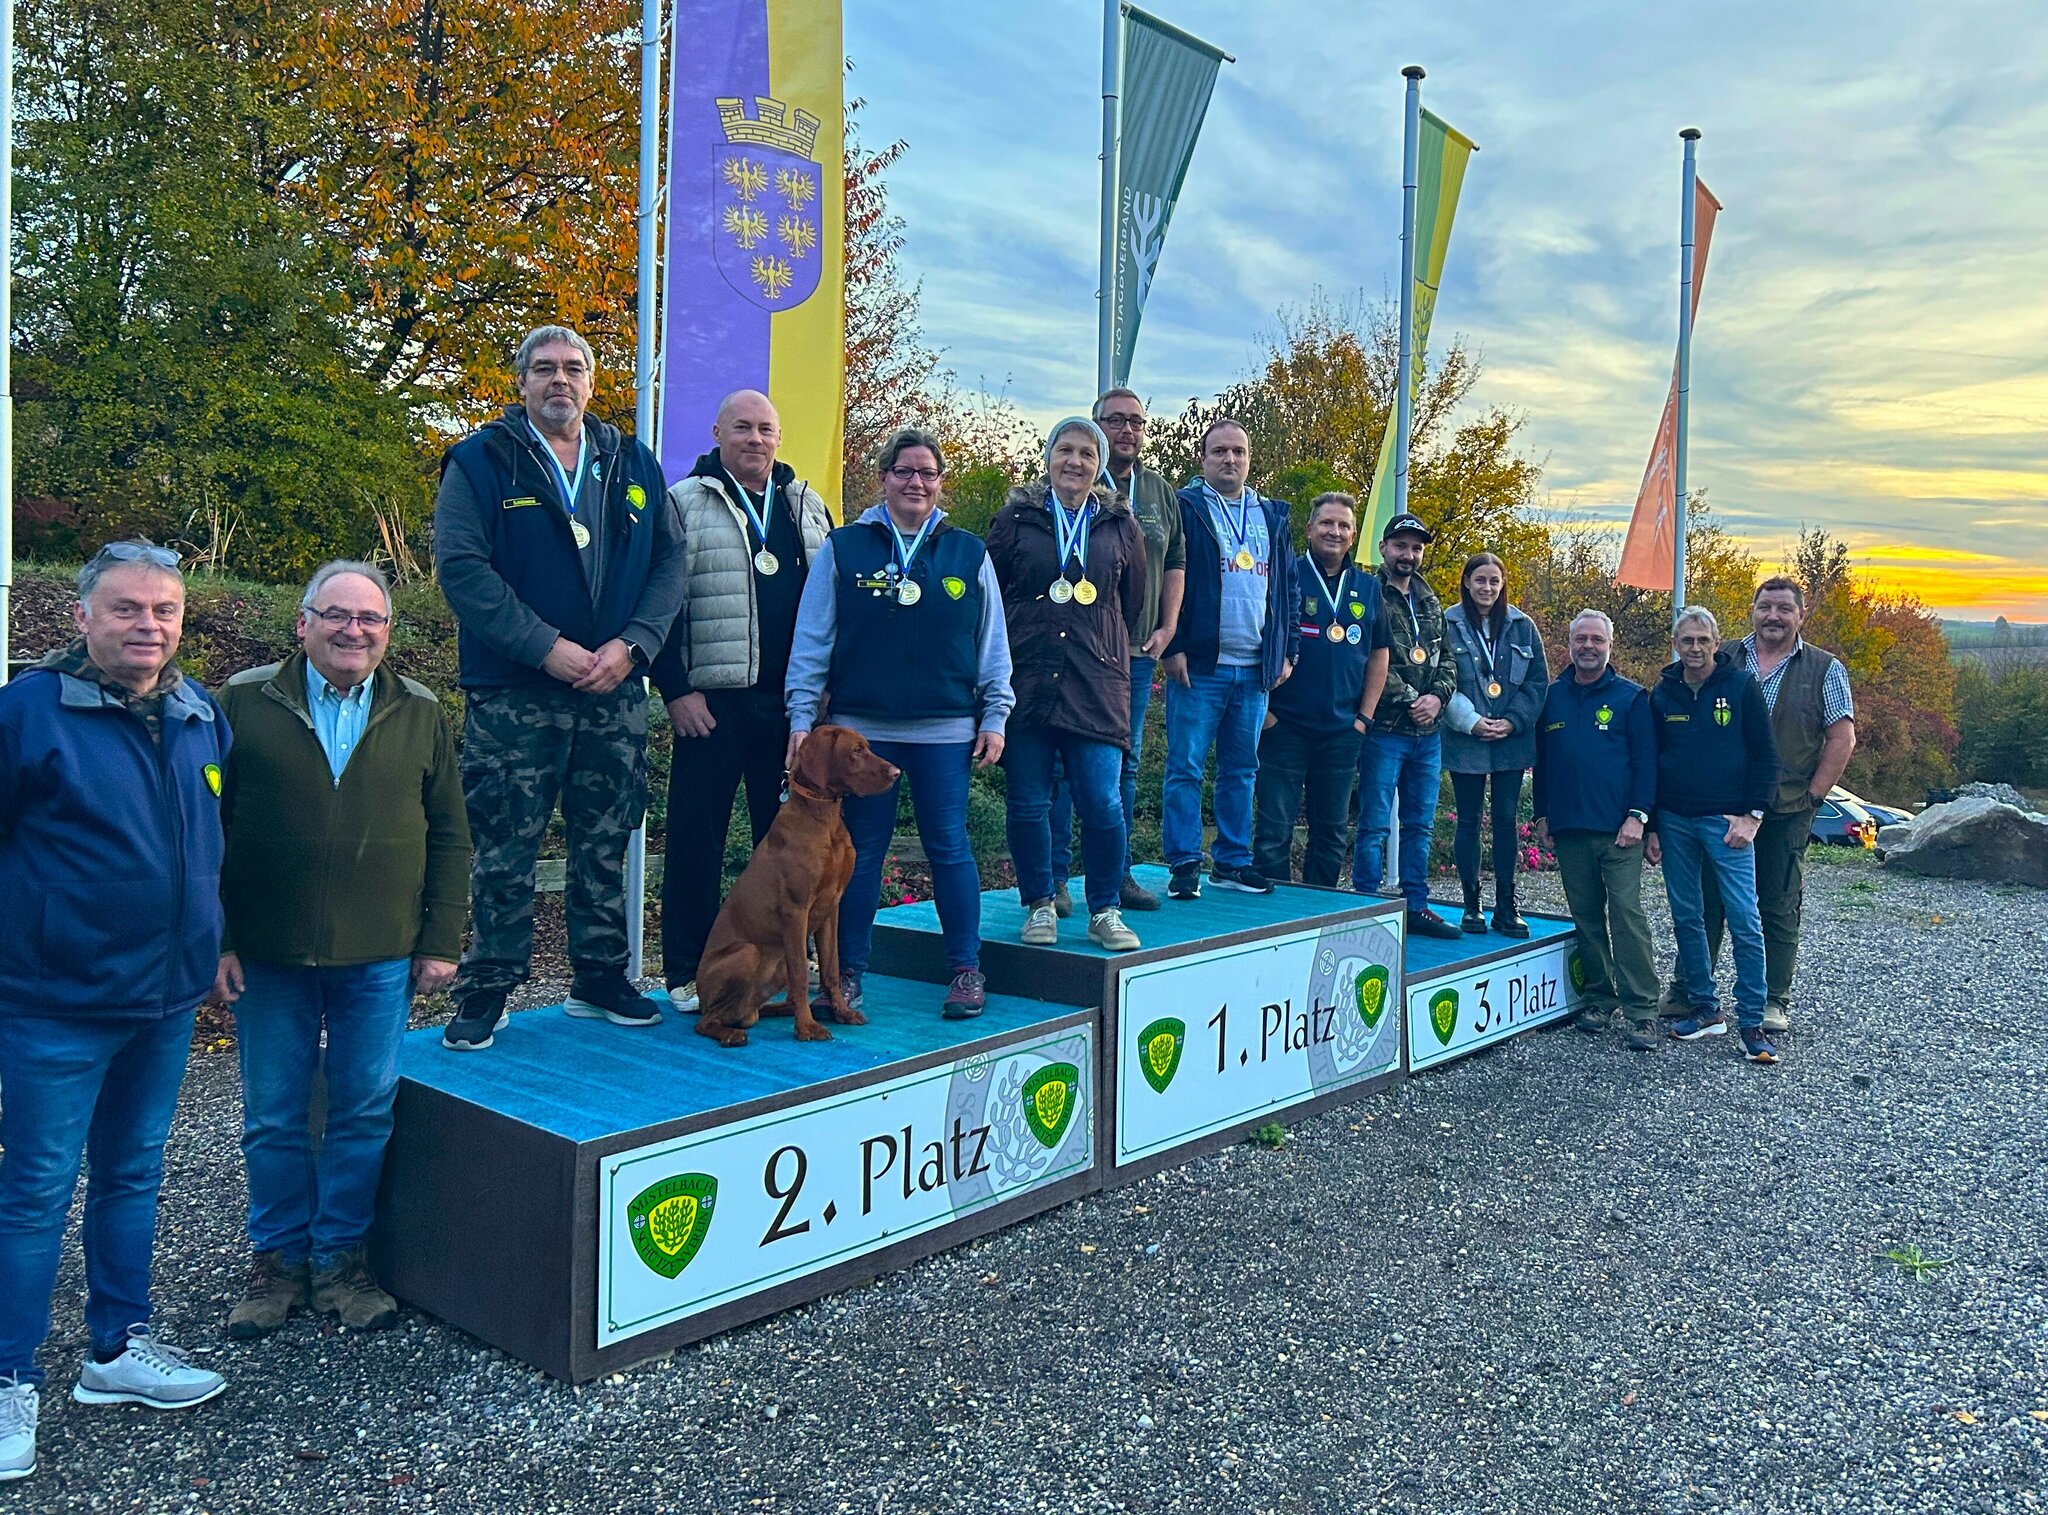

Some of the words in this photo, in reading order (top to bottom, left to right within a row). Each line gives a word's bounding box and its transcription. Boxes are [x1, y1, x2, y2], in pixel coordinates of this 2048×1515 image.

[1117, 186, 1132, 323] JAGDVERBAND
[1208, 1003, 1248, 1074] 1.
[1260, 998, 1336, 1062] Platz
[1474, 982, 1502, 1033] 3.
[1508, 971, 1558, 1022] Platz
[1025, 1067, 1077, 1093] MISTELBACH
[631, 1179, 716, 1215] MISTELBACH
[760, 1145, 838, 1247] 2.
[859, 1116, 991, 1216] Platz
